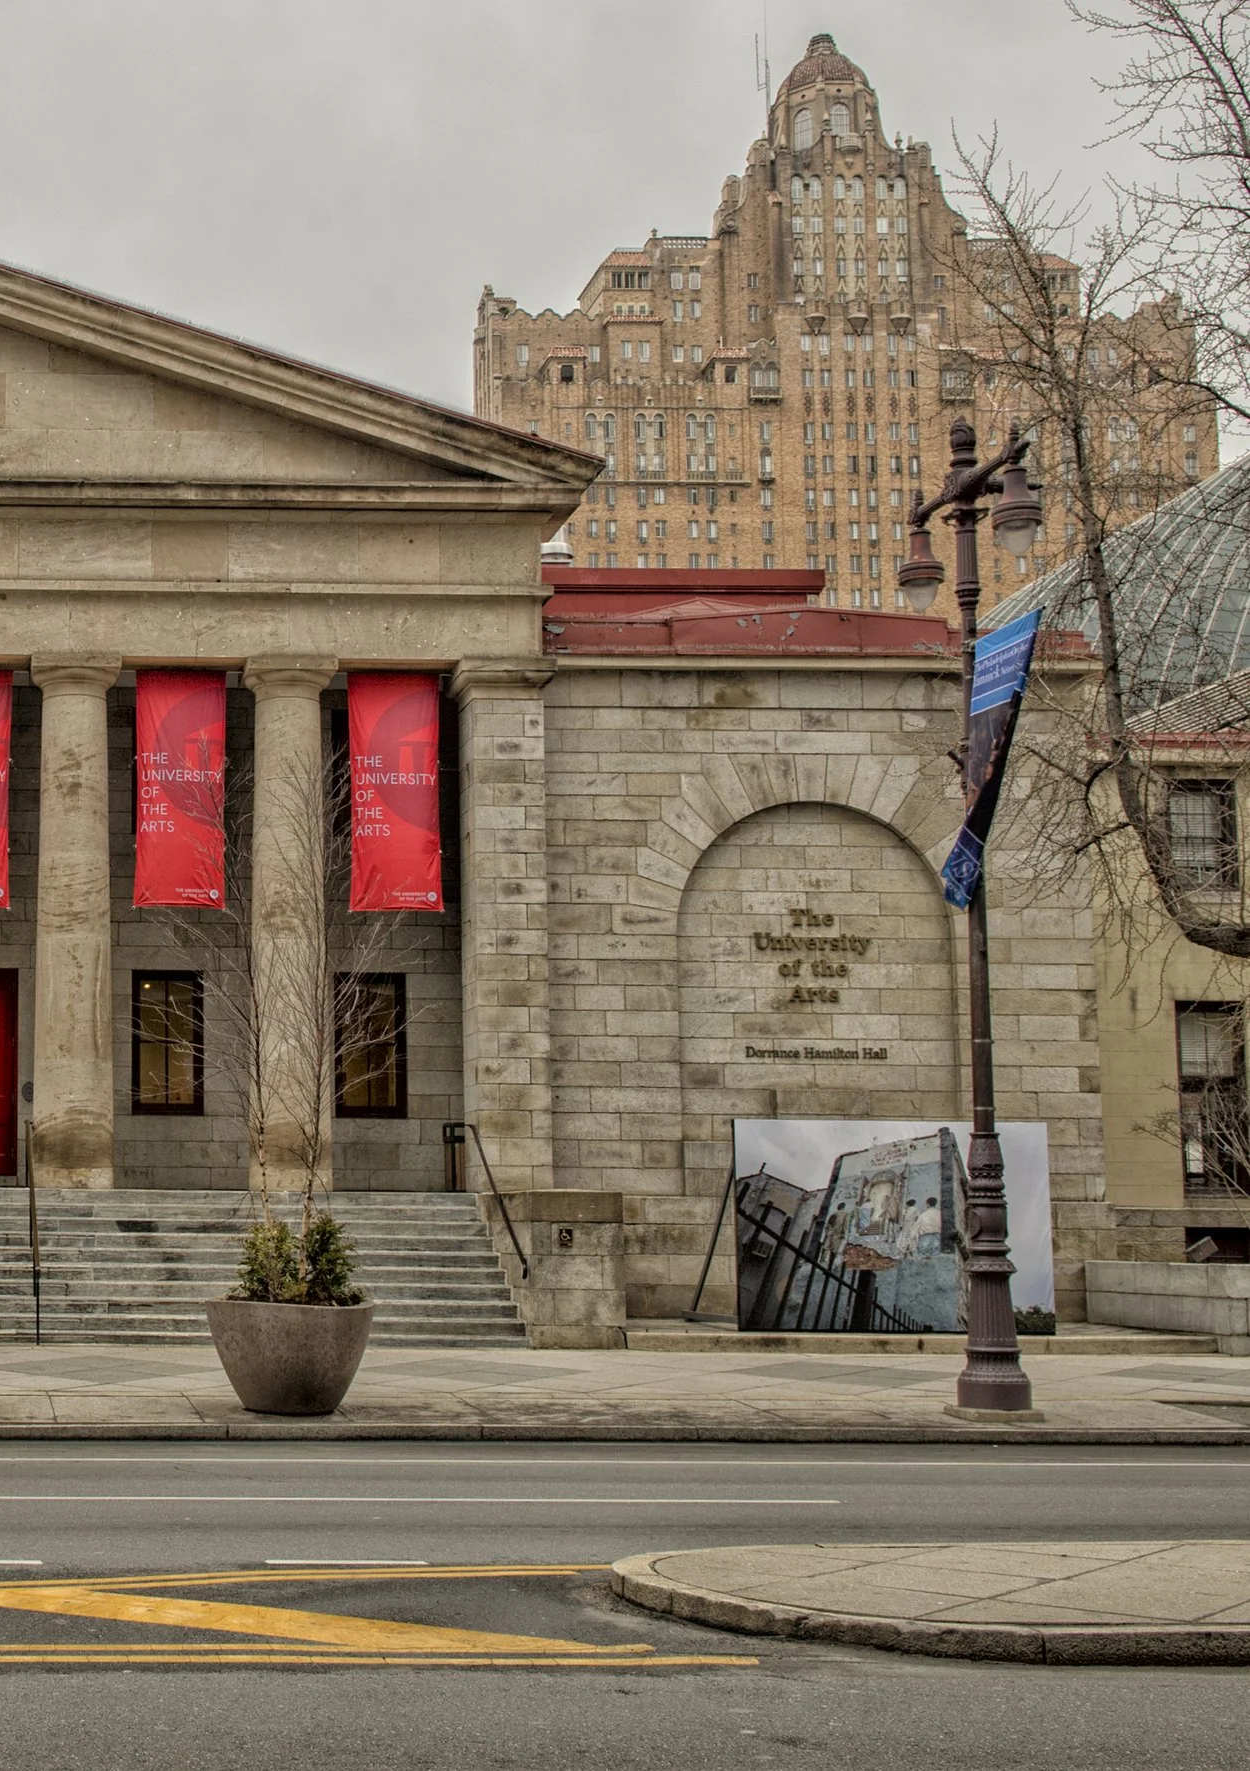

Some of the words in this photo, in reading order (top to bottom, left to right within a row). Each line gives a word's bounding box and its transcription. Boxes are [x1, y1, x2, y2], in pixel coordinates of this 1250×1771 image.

[141, 752, 168, 764] THE
[355, 755, 383, 768] THE
[141, 769, 222, 784] UNIVERSITY
[355, 772, 436, 786] UNIVERSITY
[140, 786, 160, 799] OF
[355, 789, 375, 802] OF
[141, 803, 168, 815] THE
[355, 806, 383, 819] THE
[140, 820, 175, 833] ARTS
[355, 824, 390, 837] ARTS
[789, 908, 834, 927] The
[754, 932, 871, 955] University
[778, 959, 803, 977] of
[811, 959, 848, 977] the
[790, 985, 840, 1003] Arts
[745, 1046, 800, 1059] Dorrance
[804, 1047, 859, 1059] Hamilton
[862, 1048, 888, 1059] Hall
